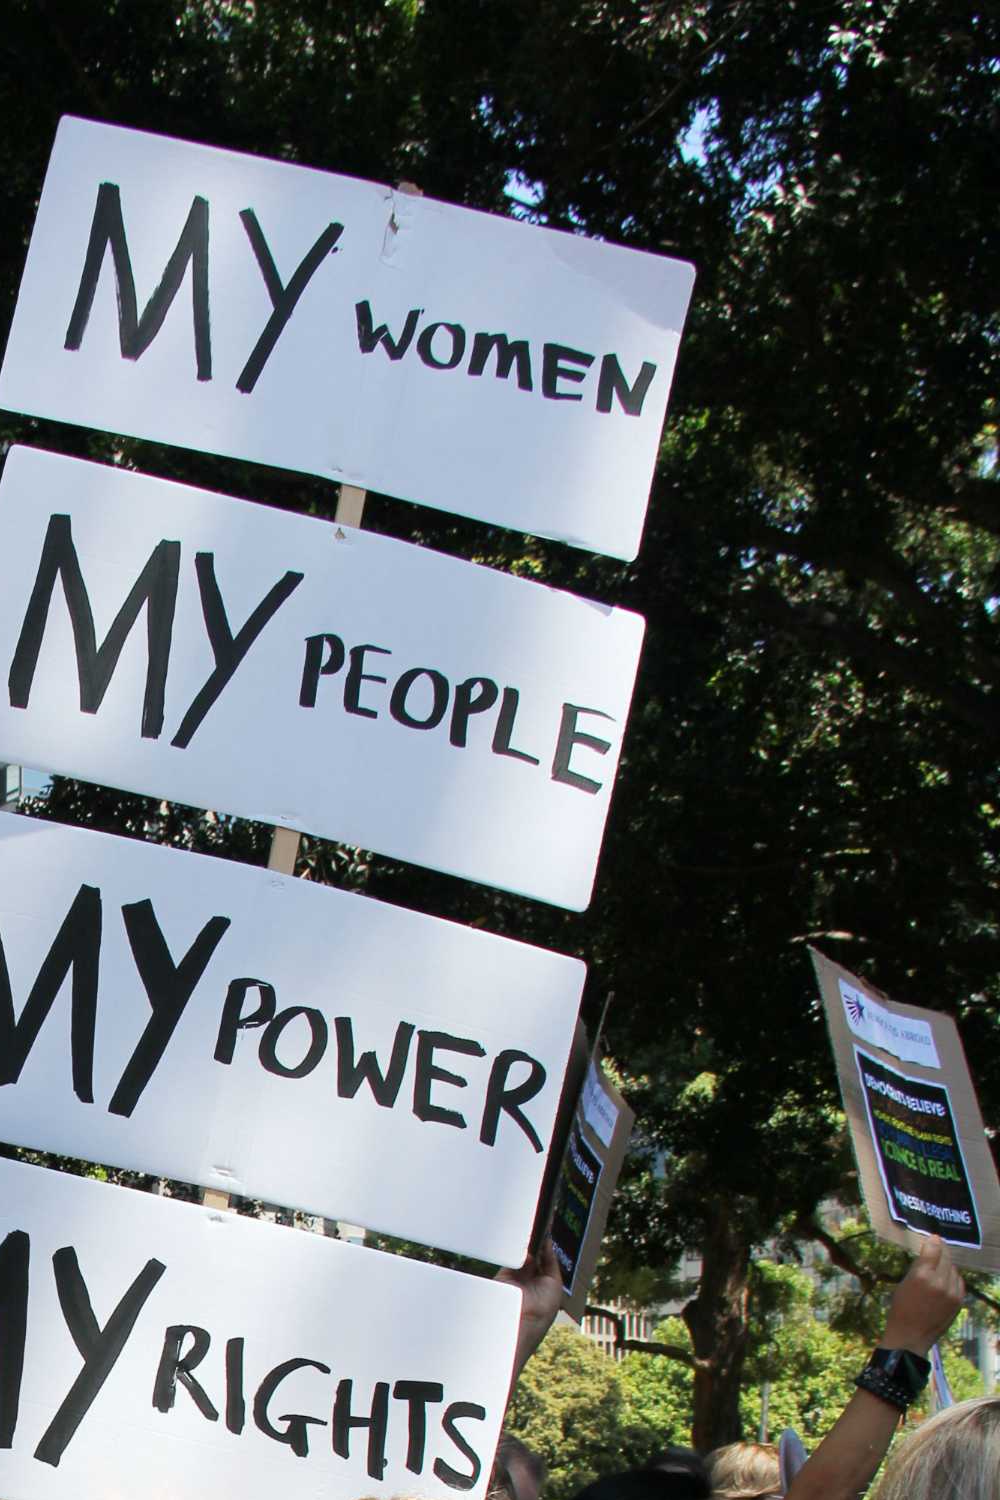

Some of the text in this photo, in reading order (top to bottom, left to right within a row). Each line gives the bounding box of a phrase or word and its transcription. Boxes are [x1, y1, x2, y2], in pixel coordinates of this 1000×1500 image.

[64, 182, 343, 394] MY
[7, 513, 616, 794] MY PEOPLE
[214, 977, 545, 1153] POWER
[928, 1158, 962, 1182] REAL
[152, 1325, 486, 1491] RIGHTS
